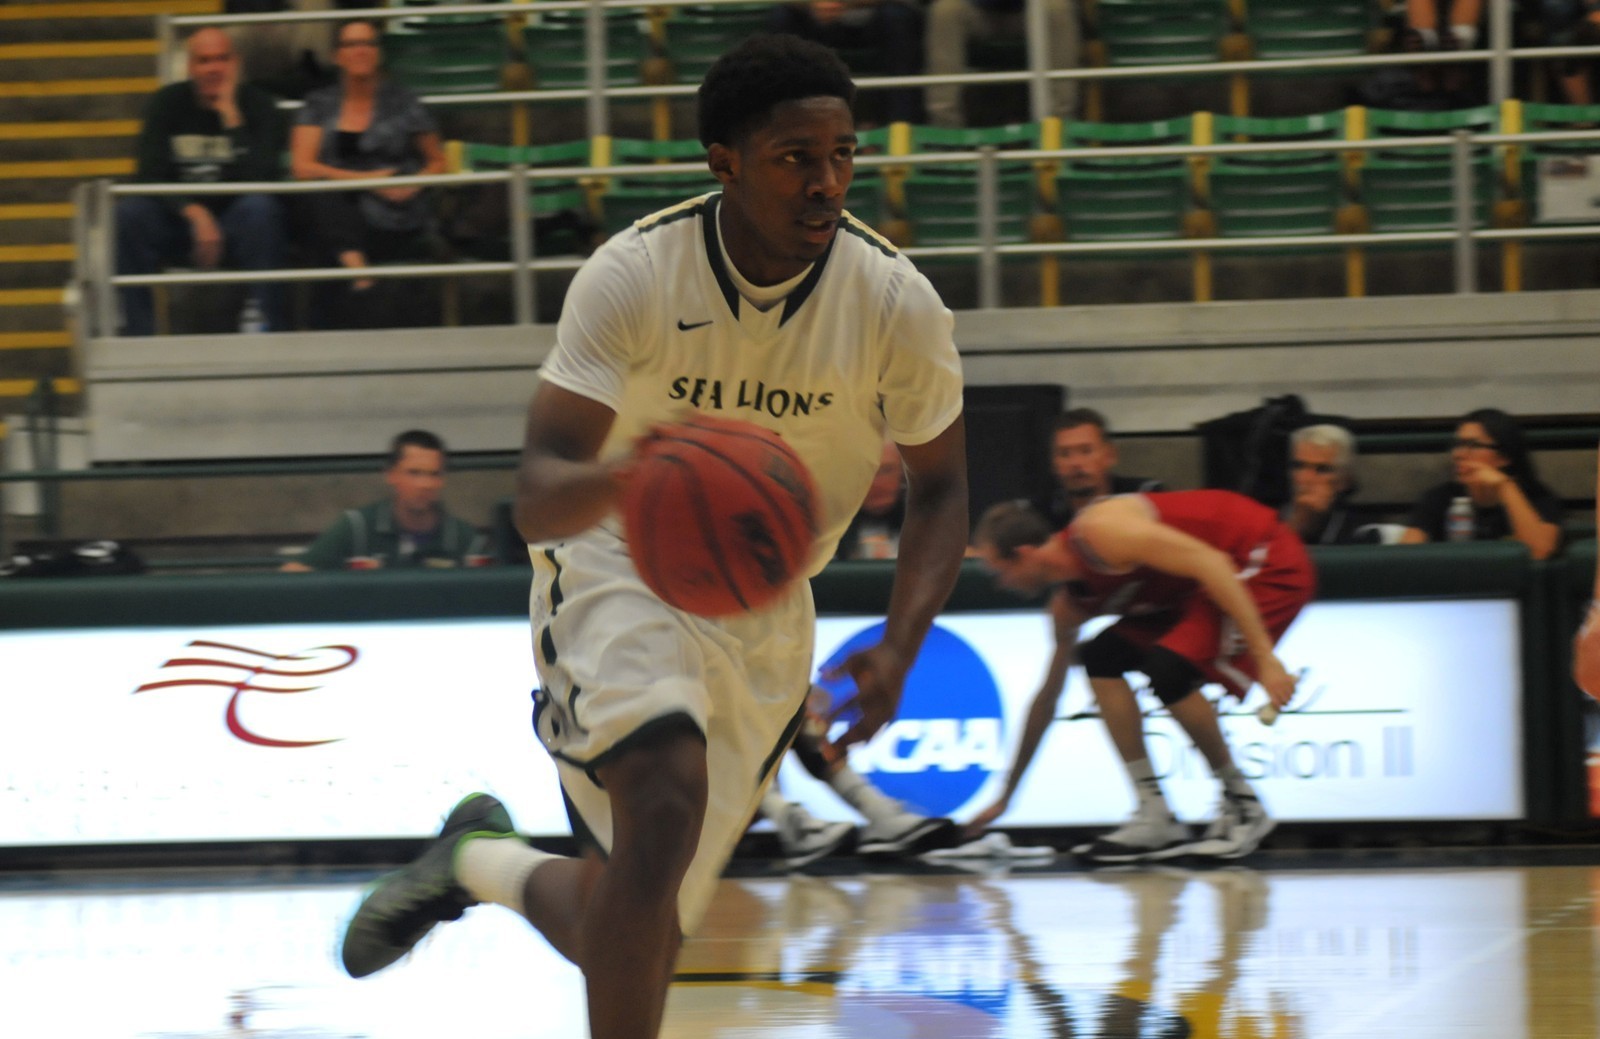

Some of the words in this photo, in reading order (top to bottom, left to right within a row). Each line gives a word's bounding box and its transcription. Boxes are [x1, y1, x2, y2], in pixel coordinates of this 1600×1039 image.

[668, 376, 723, 410] SEA
[736, 379, 834, 418] LIONS
[1142, 729, 1366, 781] Diision
